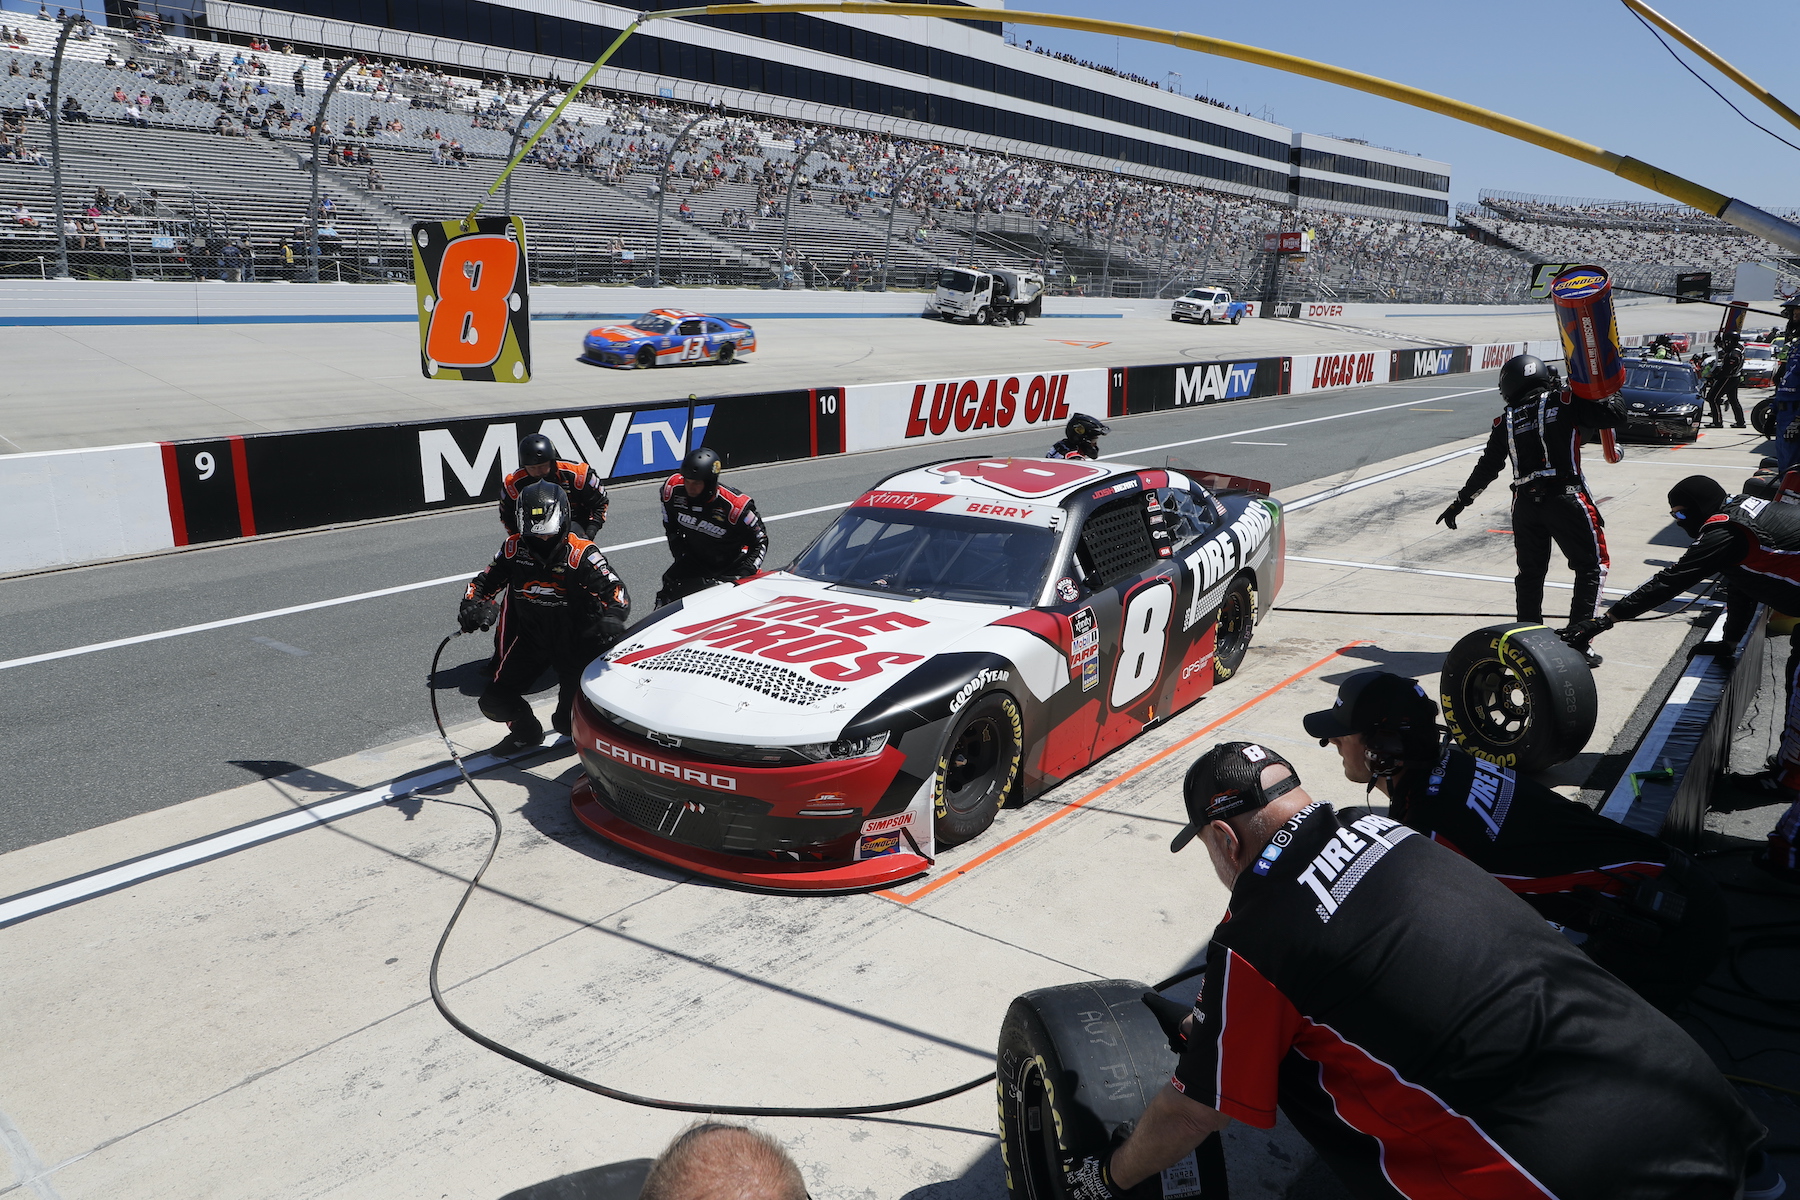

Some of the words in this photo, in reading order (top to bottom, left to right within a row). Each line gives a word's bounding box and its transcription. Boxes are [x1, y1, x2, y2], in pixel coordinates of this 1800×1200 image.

[155, 241, 173, 249] 248
[1532, 264, 1577, 298] 5
[1557, 276, 1604, 290] SUNOCO
[426, 234, 520, 368] 8
[1308, 305, 1343, 316] DOVER
[681, 337, 705, 361] 13
[1481, 346, 1505, 369] LUCAS
[1283, 361, 1289, 372] 12
[1312, 354, 1355, 389] LUCAS
[1356, 353, 1375, 384] OIL
[1524, 362, 1537, 377] 8
[1113, 373, 1122, 387] 11
[820, 395, 837, 415] 10
[905, 376, 1019, 438] LUCAS
[1024, 374, 1070, 424] OIL
[195, 450, 215, 480] 9
[864, 492, 926, 508] xfinity
[966, 503, 1033, 519] BERRY
[677, 512, 697, 526] TIRE
[697, 520, 727, 537] PROS
[1184, 531, 1235, 628] TIRE
[1229, 501, 1272, 570] PROS
[671, 595, 931, 637] TIRE
[610, 618, 926, 682] PROS
[1073, 633, 1090, 649] Mobil
[1112, 583, 1172, 708] 8
[1072, 644, 1098, 665] ARP
[1489, 638, 1536, 677] EAGLE
[1182, 661, 1200, 679] QPS
[949, 668, 1009, 714] GOODYEAR
[1563, 681, 1577, 713] 4928
[595, 738, 737, 790] CAMARO
[1242, 744, 1267, 763] 8
[935, 755, 948, 819] EAGLE
[1466, 770, 1500, 835] TIRE
[866, 813, 913, 832] SIMPSON
[861, 837, 899, 850] SUNOCO
[1297, 827, 1367, 915] TIRE
